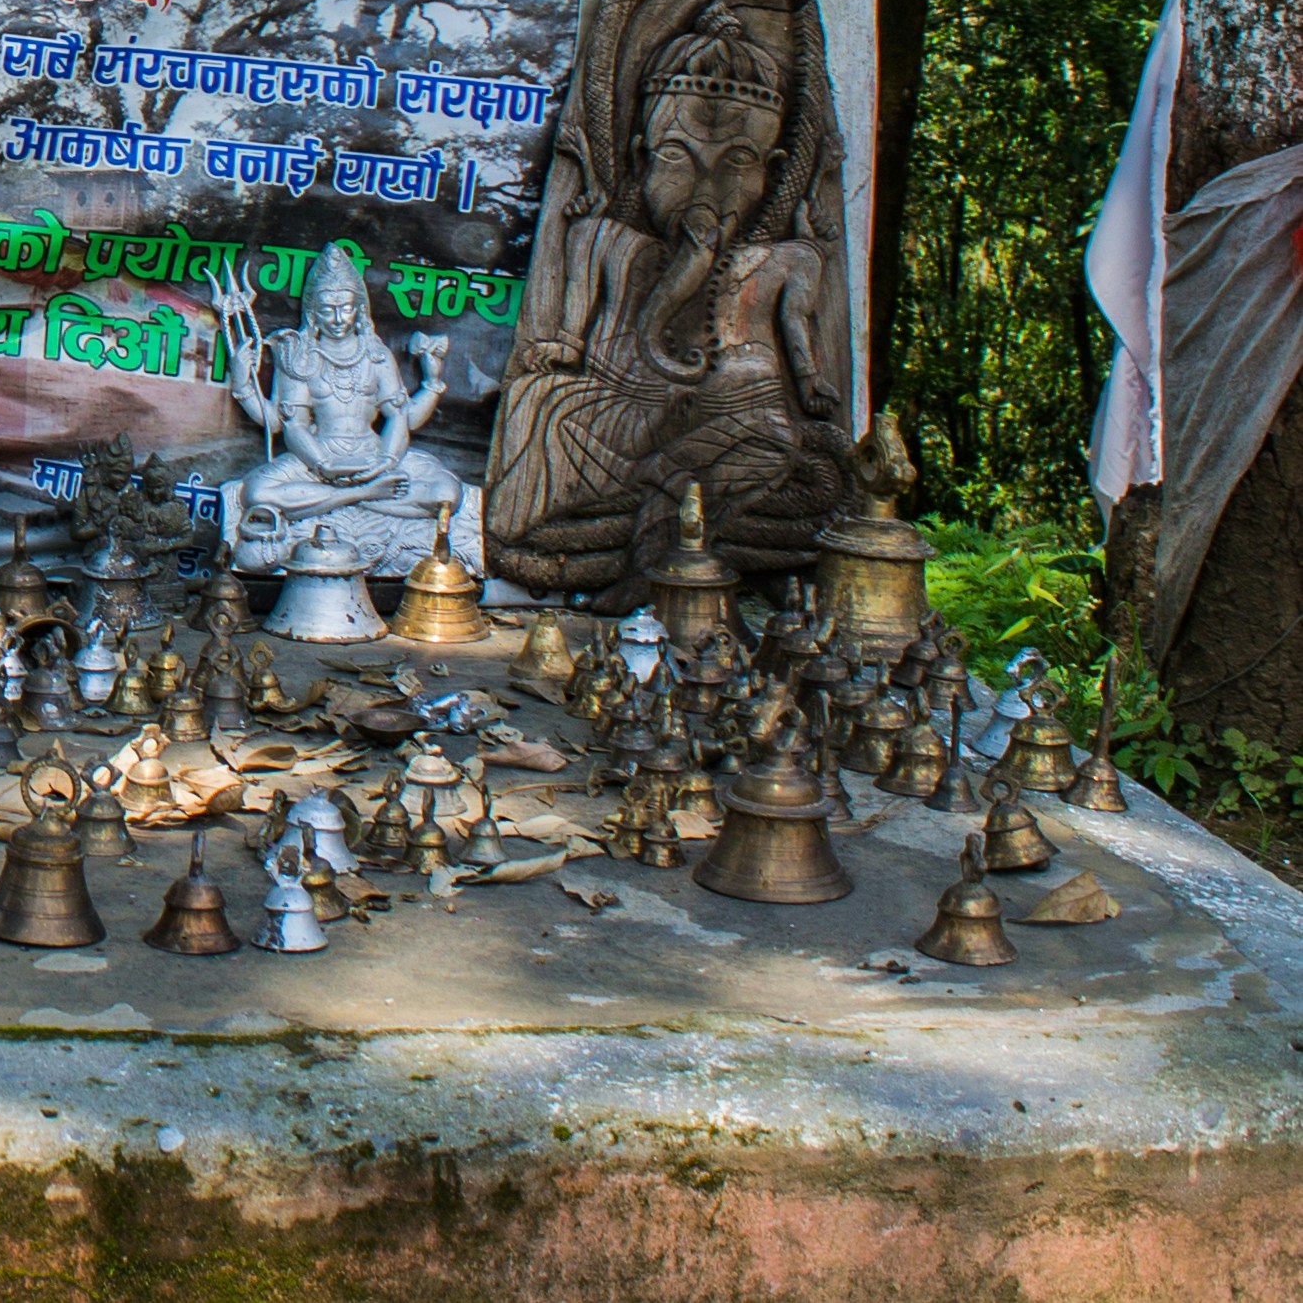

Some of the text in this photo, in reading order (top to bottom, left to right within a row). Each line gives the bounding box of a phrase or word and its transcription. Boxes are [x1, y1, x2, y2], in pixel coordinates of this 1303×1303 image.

[2, 33, 83, 80] सबै
[95, 36, 384, 108] संरचनाहरुको
[396, 61, 551, 129] संरक्षण
[5, 118, 191, 174] आकर्षक
[205, 137, 325, 197] बनाई
